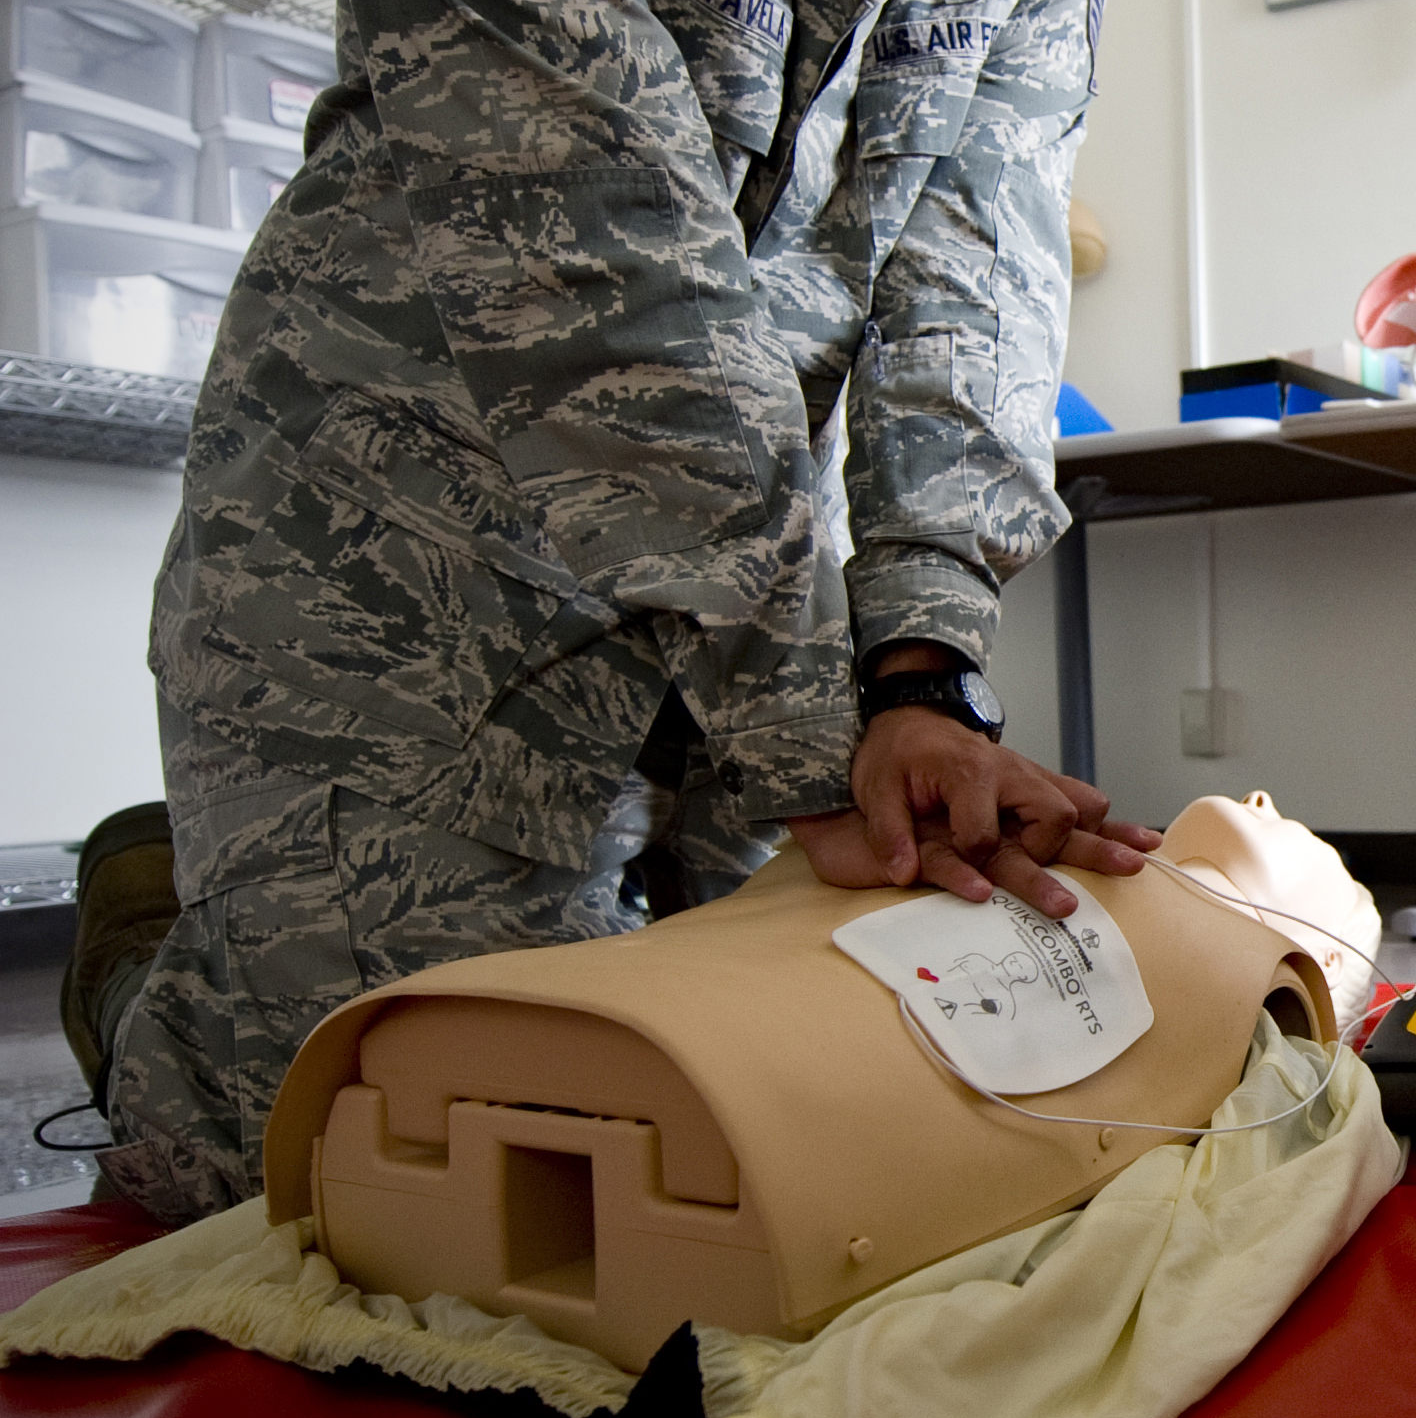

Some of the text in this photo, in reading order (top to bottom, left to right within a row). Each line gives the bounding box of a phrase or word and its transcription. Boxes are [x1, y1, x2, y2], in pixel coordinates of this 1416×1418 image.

[873, 28, 919, 61] U.S.
[928, 22, 974, 52] AIR
[1056, 921, 1093, 973] Medtronic
[1075, 1000, 1103, 1035] RTS
